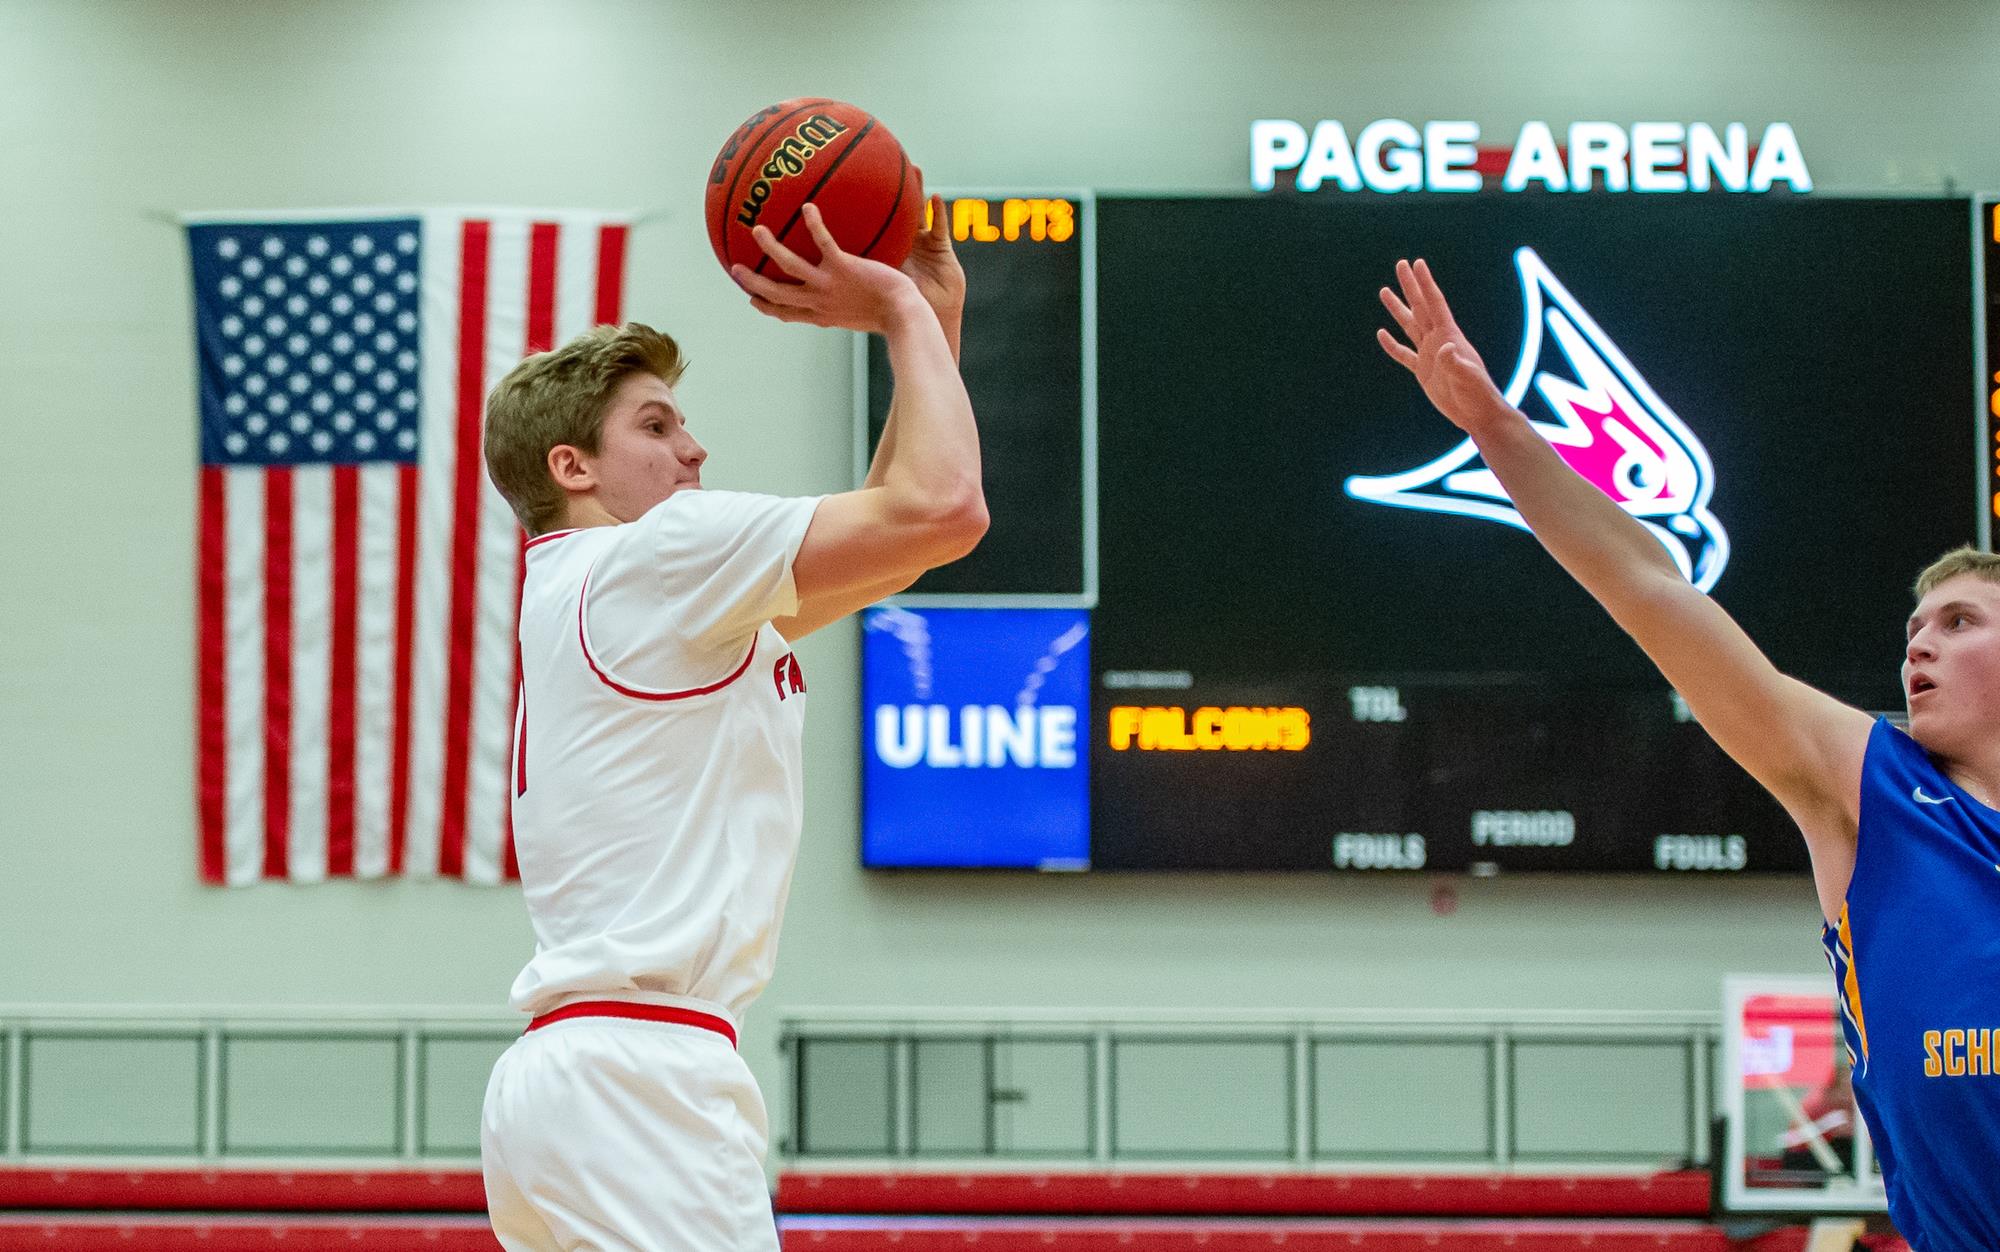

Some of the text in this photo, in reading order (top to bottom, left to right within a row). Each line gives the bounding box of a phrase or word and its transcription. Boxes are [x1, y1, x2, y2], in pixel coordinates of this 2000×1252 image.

[737, 113, 850, 227] Wilson
[1251, 119, 1813, 193] PAGE ARENA
[1003, 198, 1074, 242] PTS
[773, 651, 807, 701] FA
[875, 704, 1077, 769] ULINE
[1110, 706, 1310, 751] FALCONS
[1471, 810, 1575, 846] PERIOD
[1333, 833, 1426, 870] FOULS
[1654, 834, 1747, 871] FOULS
